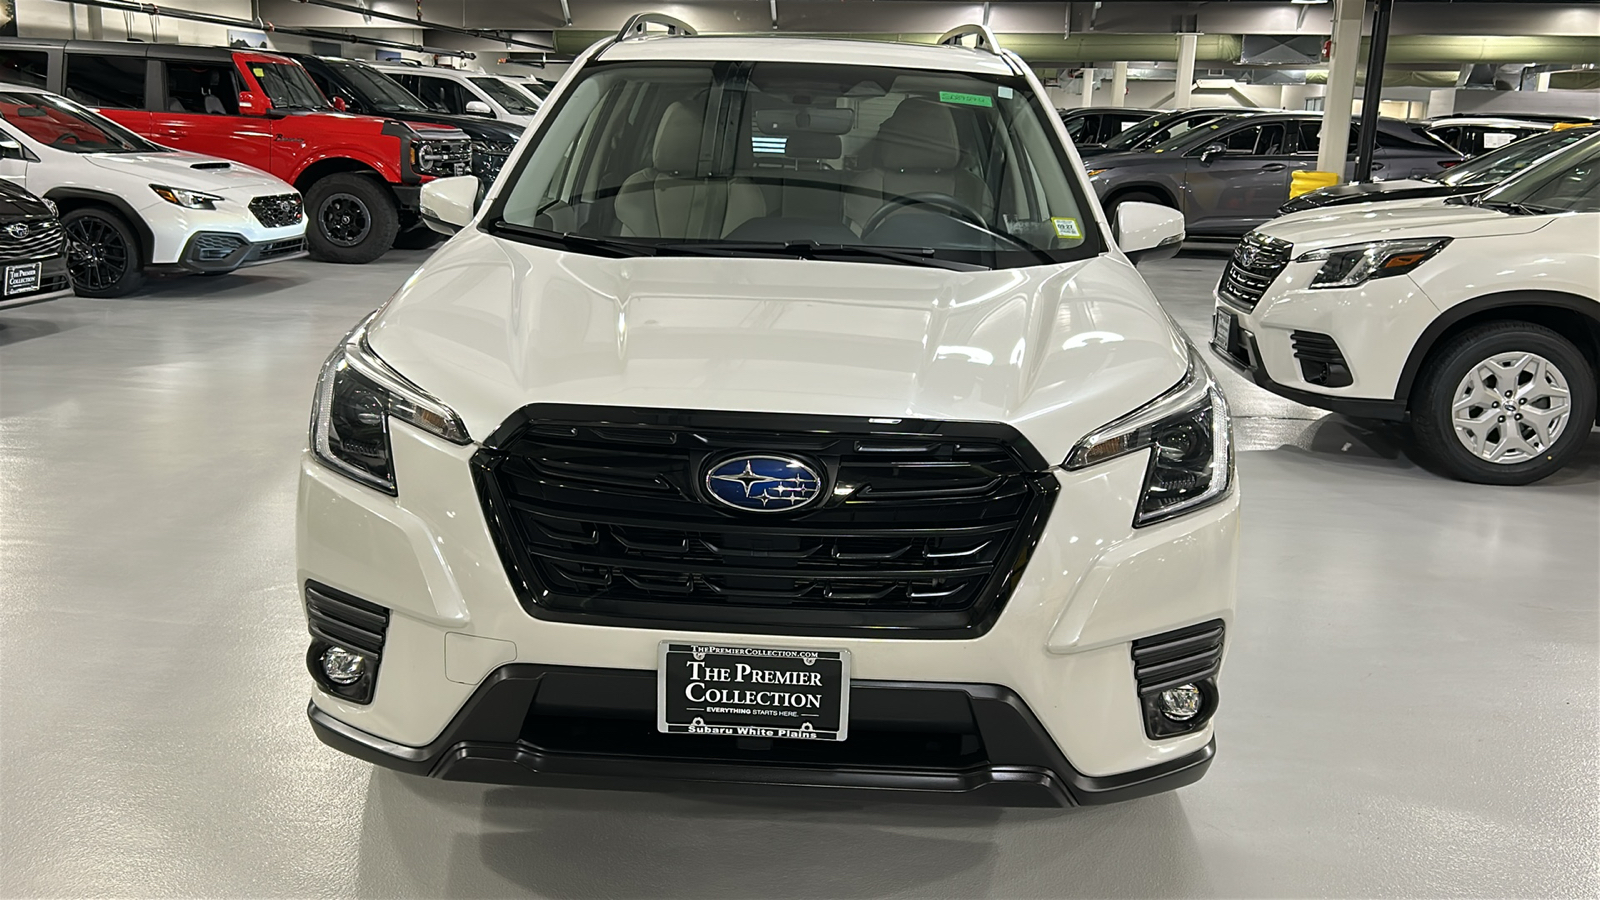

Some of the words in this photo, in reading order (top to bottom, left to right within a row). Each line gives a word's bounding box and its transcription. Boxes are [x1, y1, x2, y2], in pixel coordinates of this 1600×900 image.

[686, 661, 731, 682] THE
[735, 663, 823, 687] PREMIER
[685, 682, 822, 708] COLLECTION
[706, 706, 751, 715] EVERYTHING
[752, 709, 778, 717] STARTS
[688, 725, 734, 735] Subaru
[737, 726, 774, 737] White
[778, 729, 818, 739] Plains
